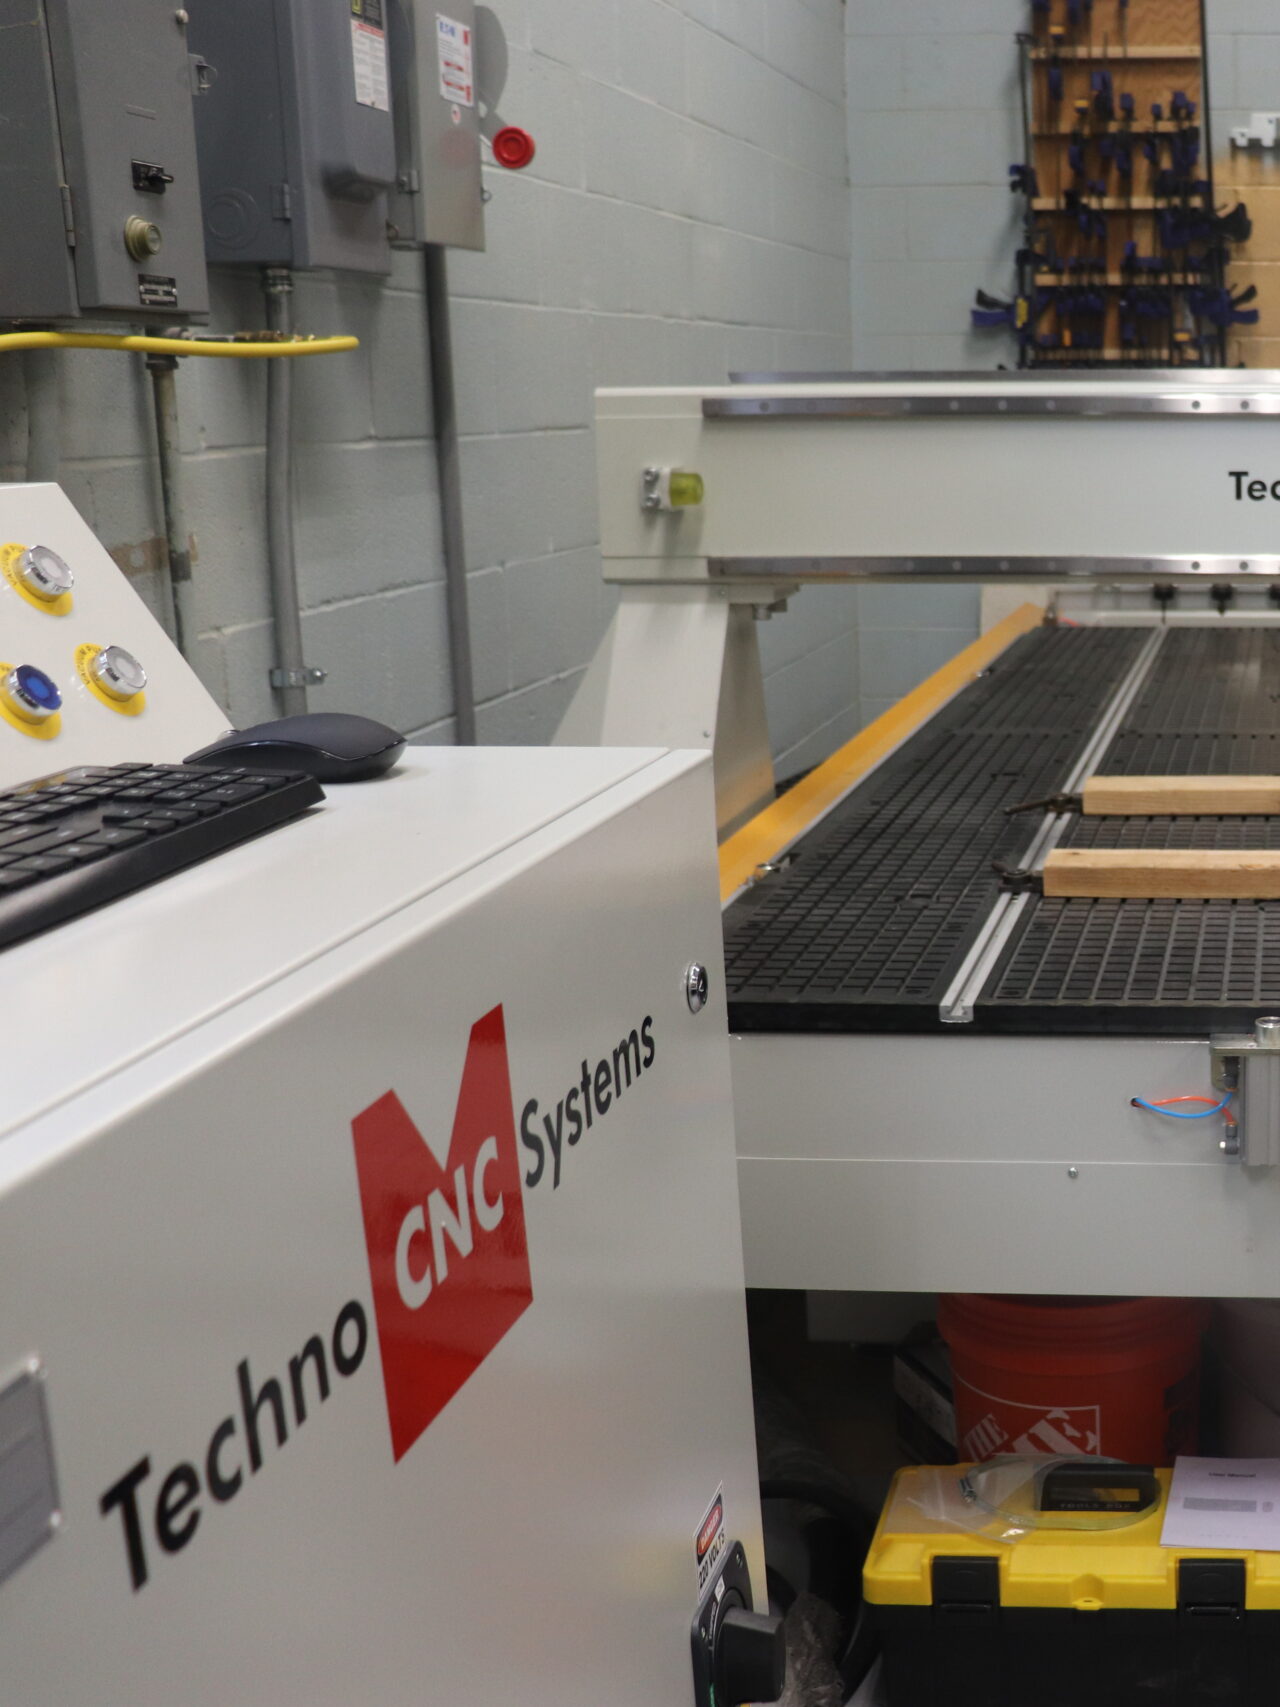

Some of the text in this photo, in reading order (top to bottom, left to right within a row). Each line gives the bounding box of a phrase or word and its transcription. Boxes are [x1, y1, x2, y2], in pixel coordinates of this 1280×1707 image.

[100, 1014, 657, 1595] Techno CNC Systems
[708, 1527, 725, 1569] VOLTS
